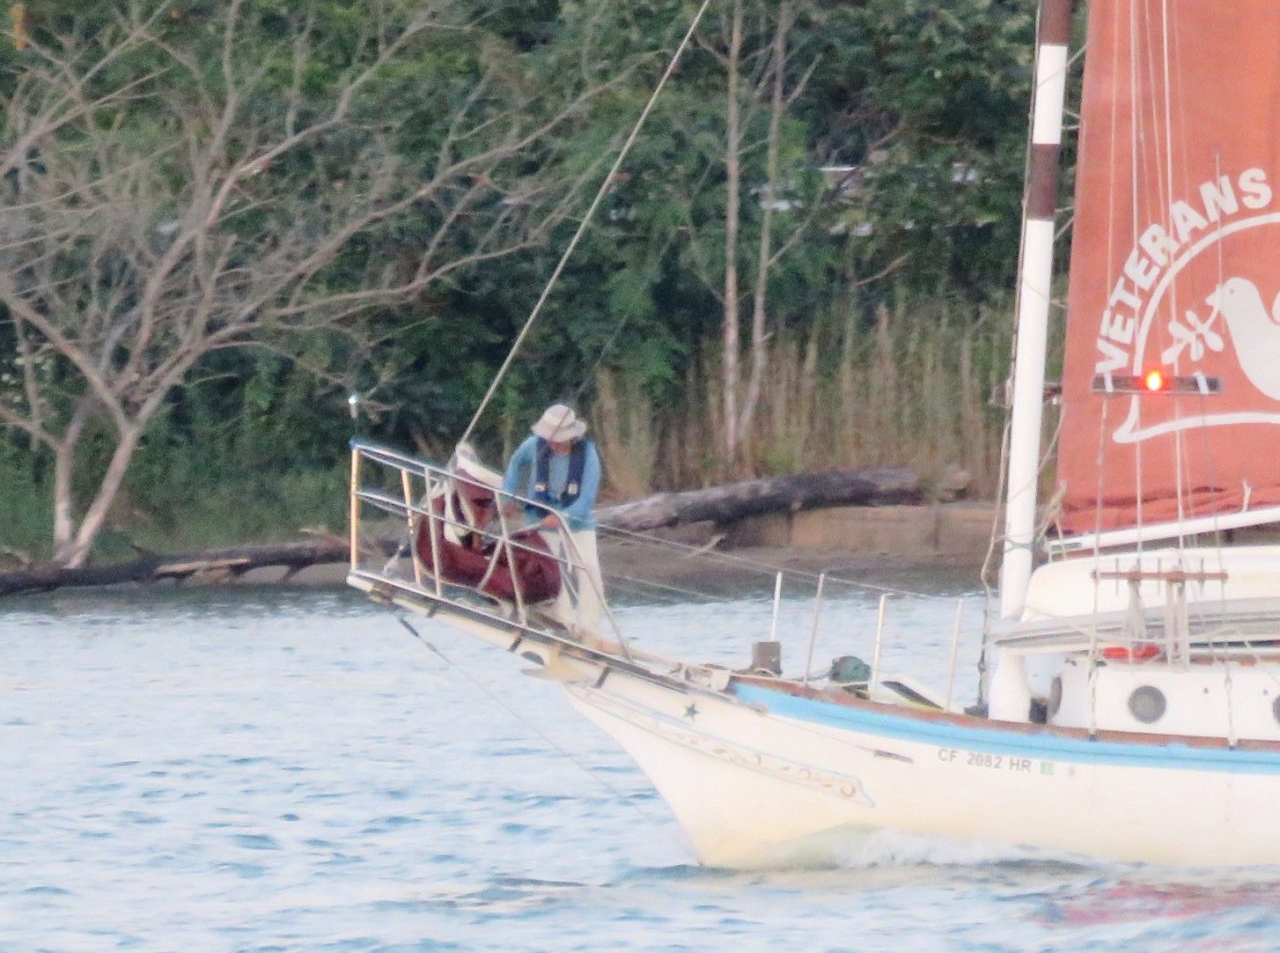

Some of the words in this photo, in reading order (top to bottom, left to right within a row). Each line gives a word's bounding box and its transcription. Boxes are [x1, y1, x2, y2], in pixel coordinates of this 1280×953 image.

[1095, 167, 1272, 373] VETERANS
[937, 748, 958, 762] CF
[1008, 758, 1032, 774] HR
